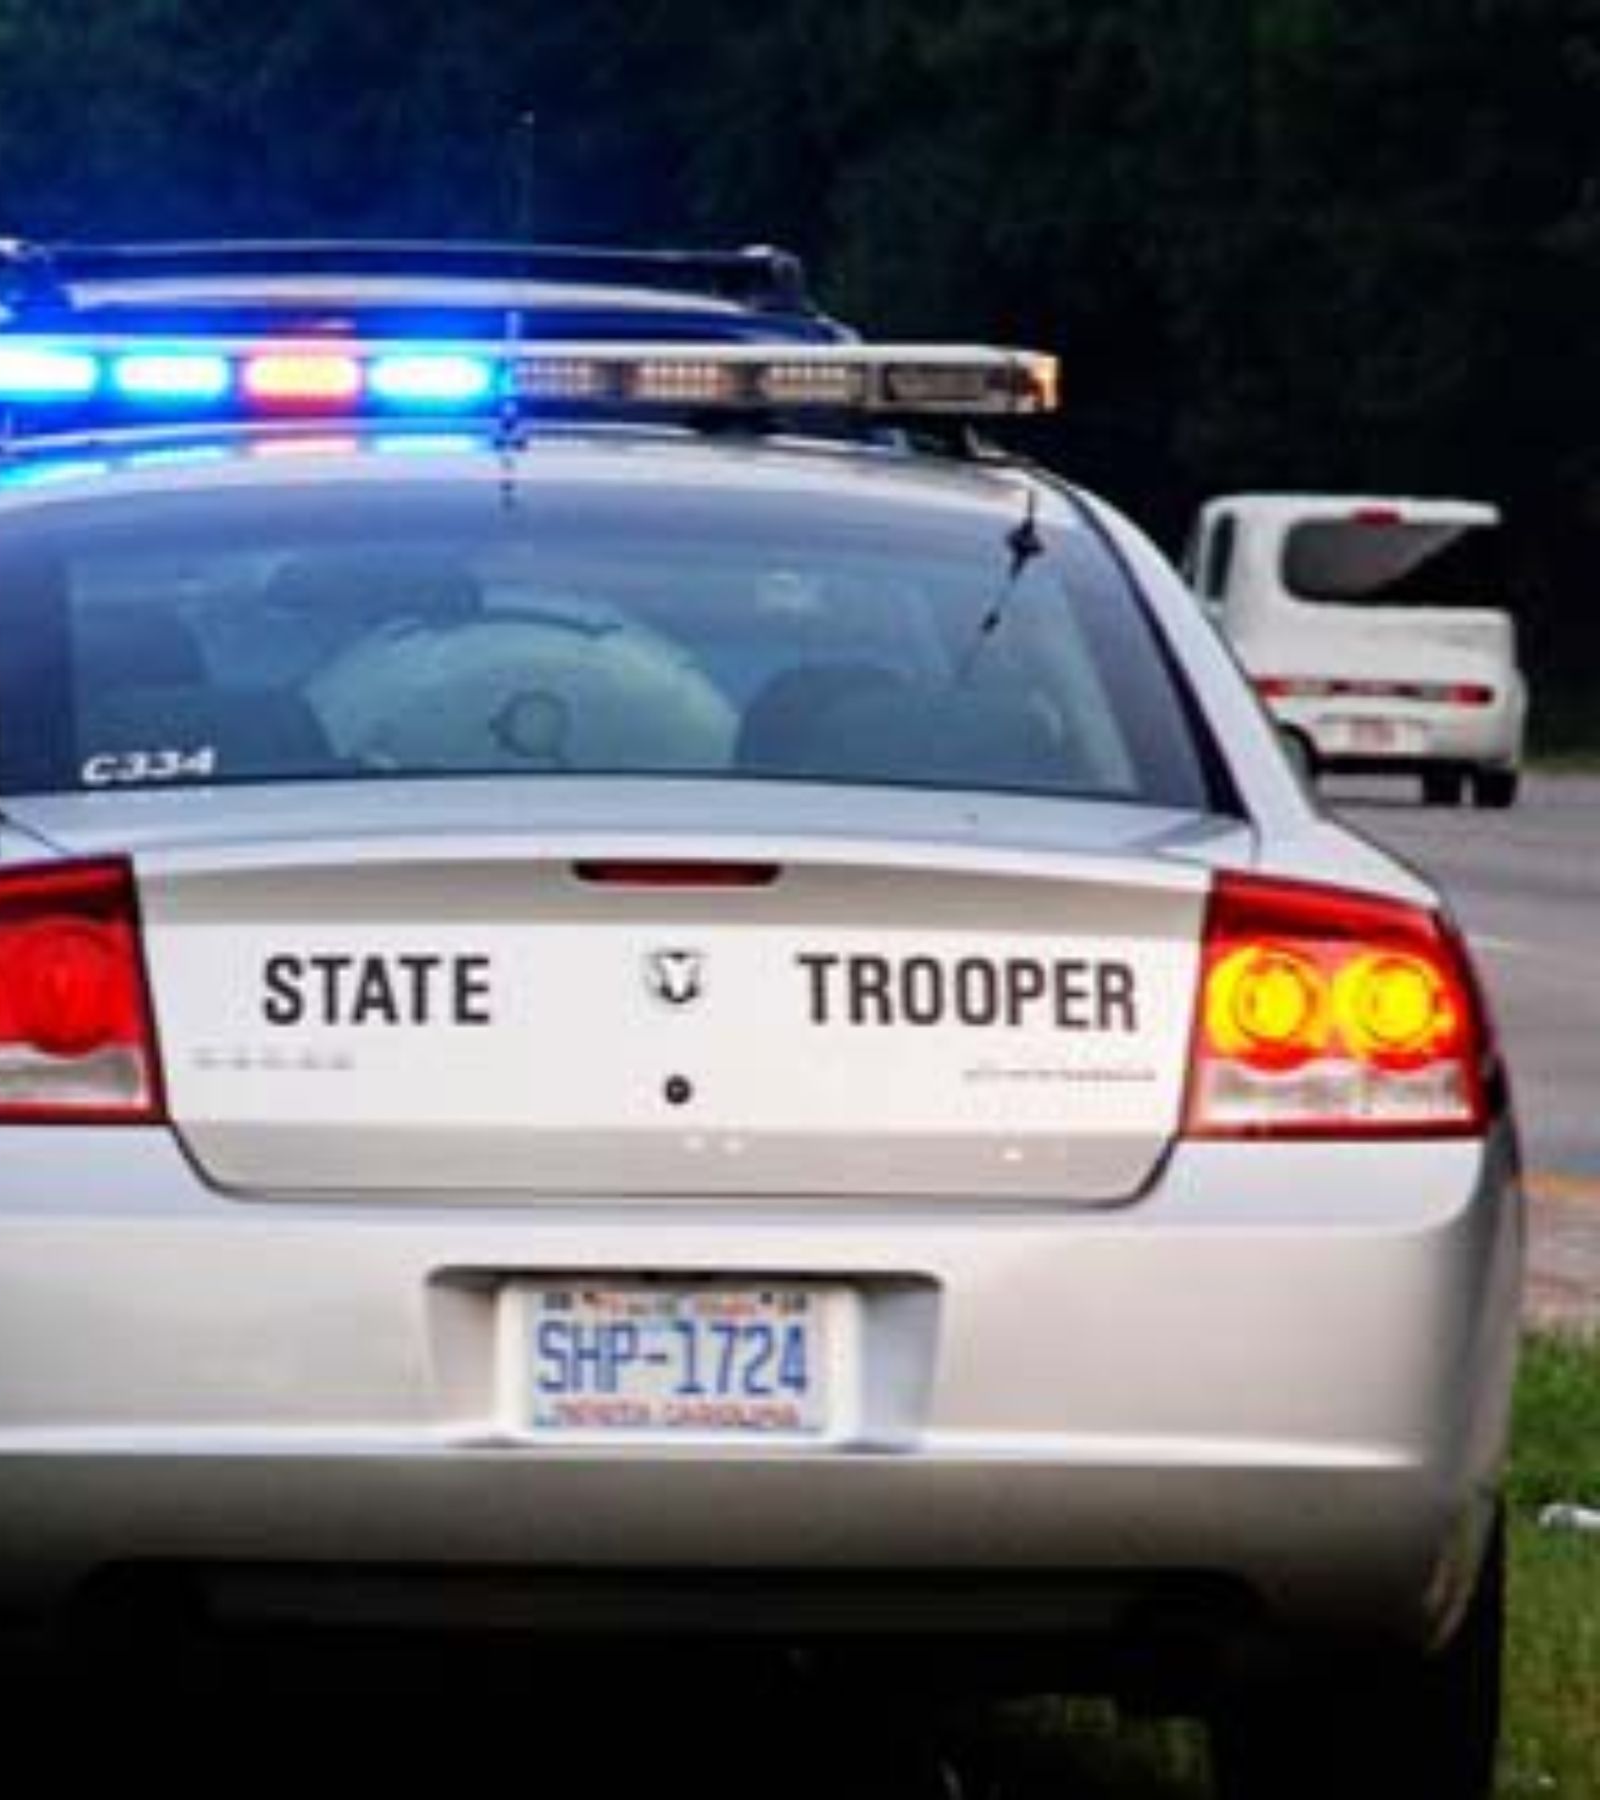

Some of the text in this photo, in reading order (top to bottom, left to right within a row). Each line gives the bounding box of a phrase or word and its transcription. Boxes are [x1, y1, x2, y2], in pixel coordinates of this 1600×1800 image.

[81, 746, 217, 786] C334
[262, 952, 1138, 1033] STATE TROOPER
[535, 1319, 809, 1395] SHP-1724
